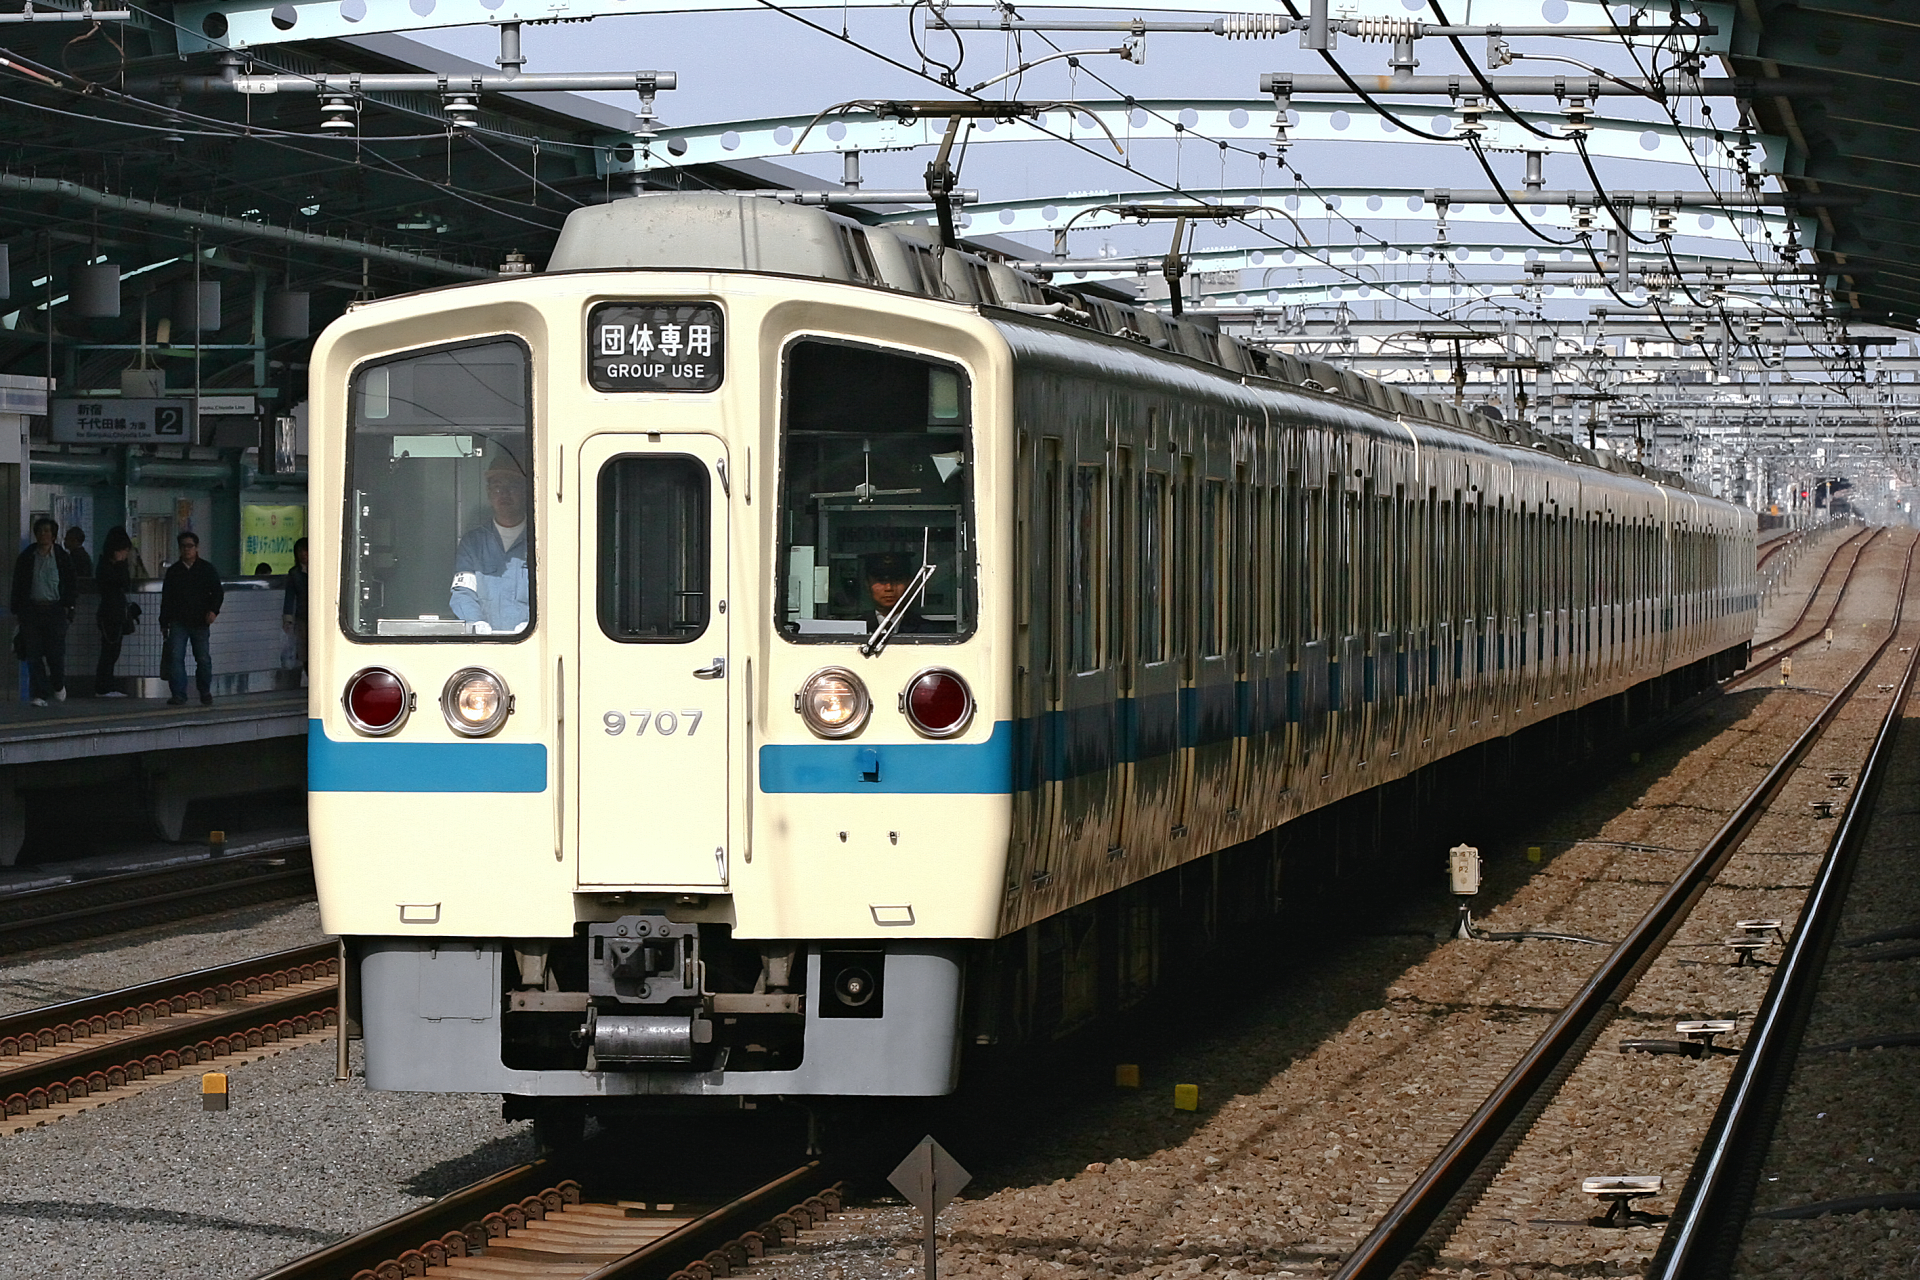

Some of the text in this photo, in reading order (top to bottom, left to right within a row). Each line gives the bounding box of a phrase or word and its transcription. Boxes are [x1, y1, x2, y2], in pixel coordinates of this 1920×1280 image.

[259, 83, 266, 92] 6
[601, 323, 712, 357] 団体専用
[607, 364, 705, 378] GROUP USE
[78, 404, 102, 416] 新宿
[77, 418, 127, 430] 千代田線
[161, 410, 177, 433] 2
[603, 709, 703, 736] 9707
